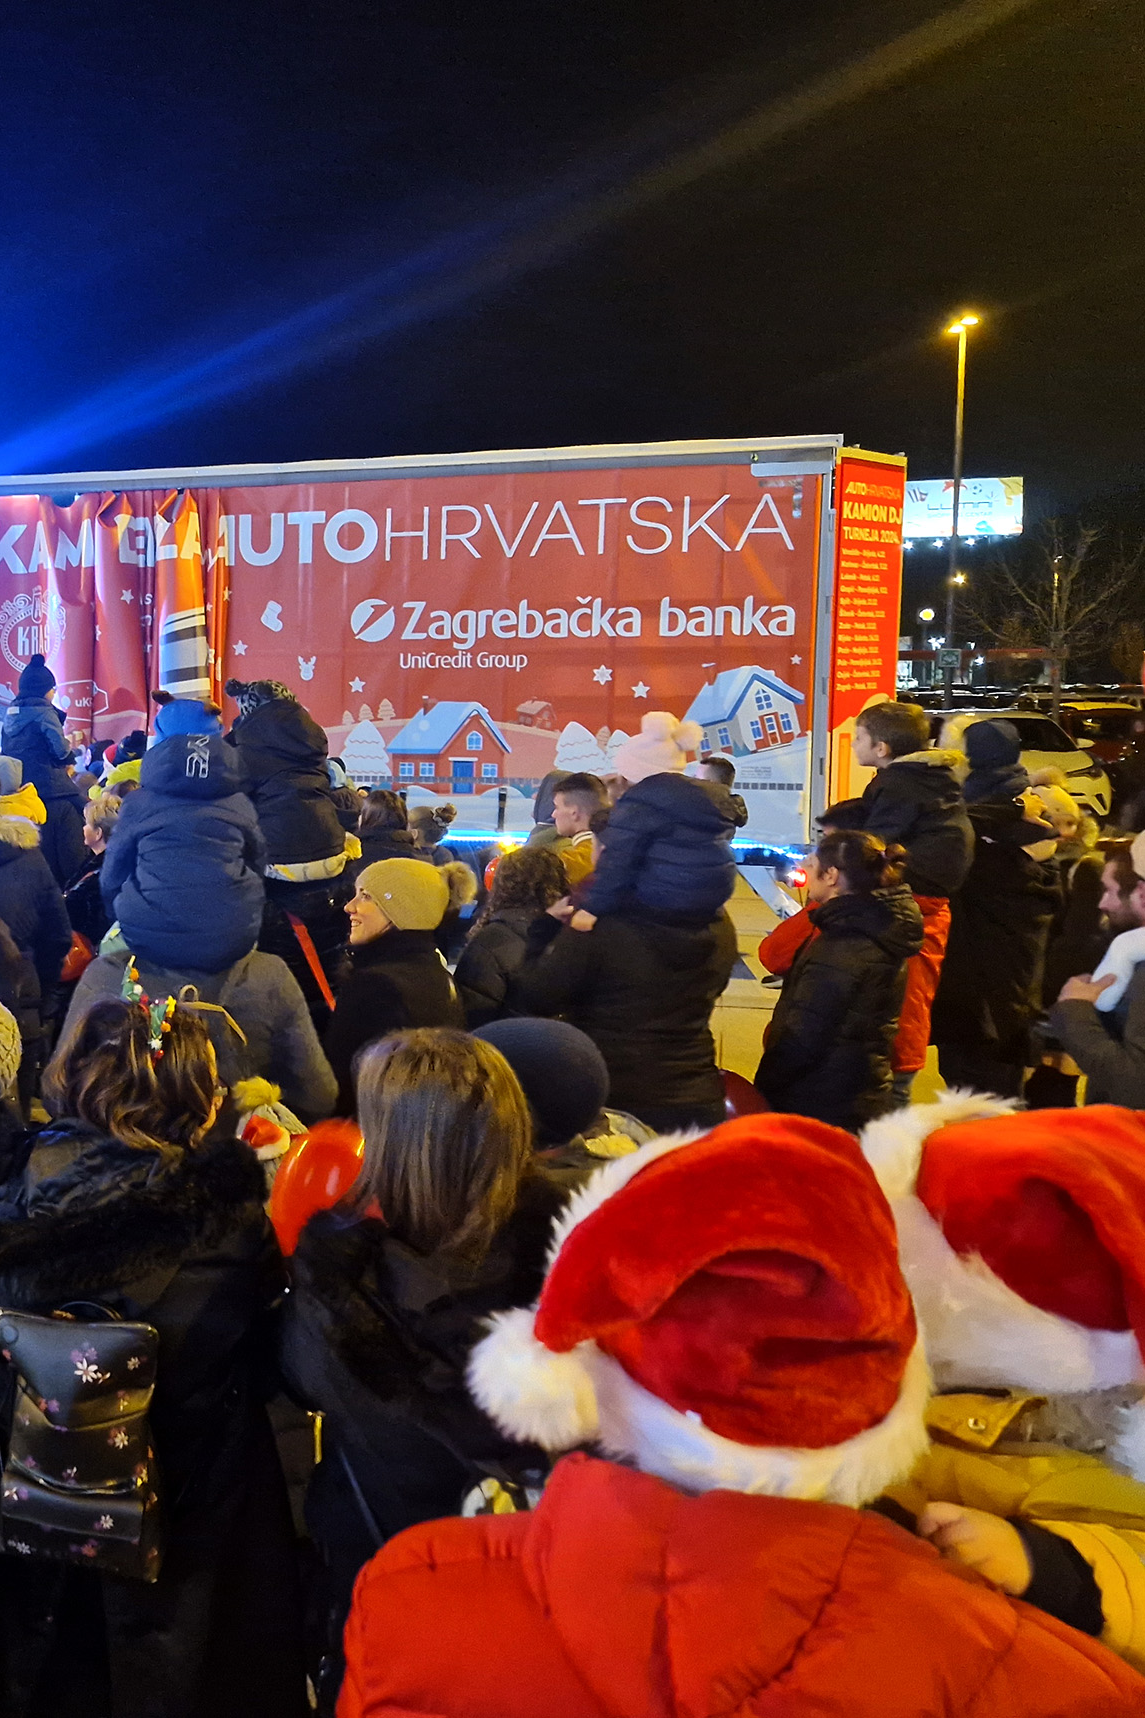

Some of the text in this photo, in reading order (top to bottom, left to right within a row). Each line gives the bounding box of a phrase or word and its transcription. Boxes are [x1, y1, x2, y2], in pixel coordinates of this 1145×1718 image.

[843, 501, 888, 523] KAMION
[843, 526, 879, 542] TURNEJA
[400, 595, 796, 650] Zagrebačka banka
[399, 650, 529, 672] UniCredit Group
